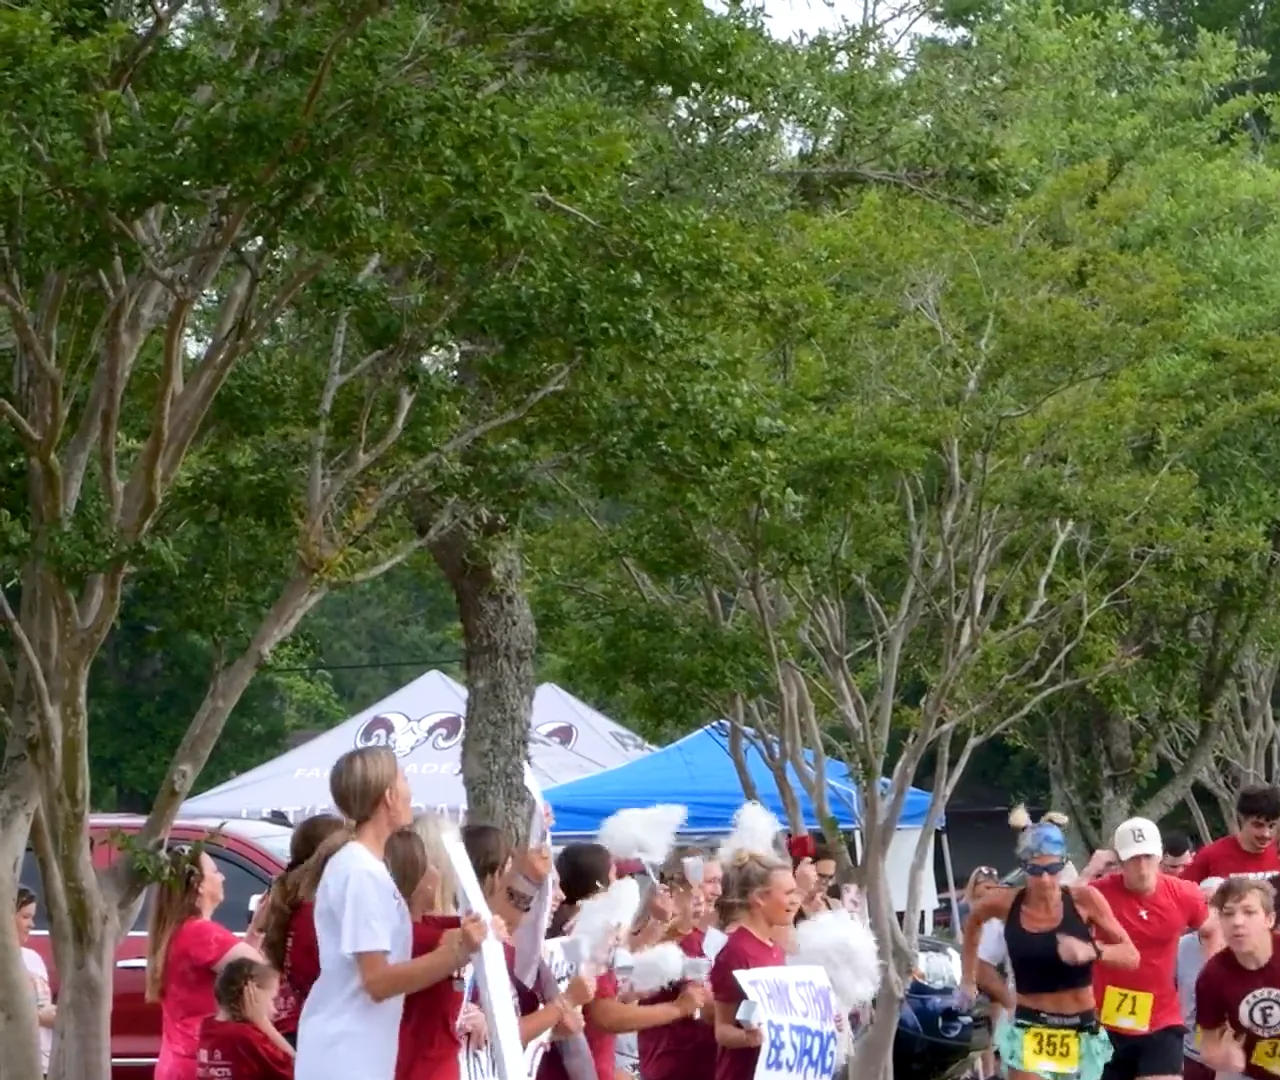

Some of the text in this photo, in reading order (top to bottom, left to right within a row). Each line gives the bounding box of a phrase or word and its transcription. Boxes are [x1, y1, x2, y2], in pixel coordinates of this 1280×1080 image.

[1116, 992, 1137, 1016] 71
[766, 1019, 786, 1072] BE
[1032, 1031, 1071, 1058] 355
